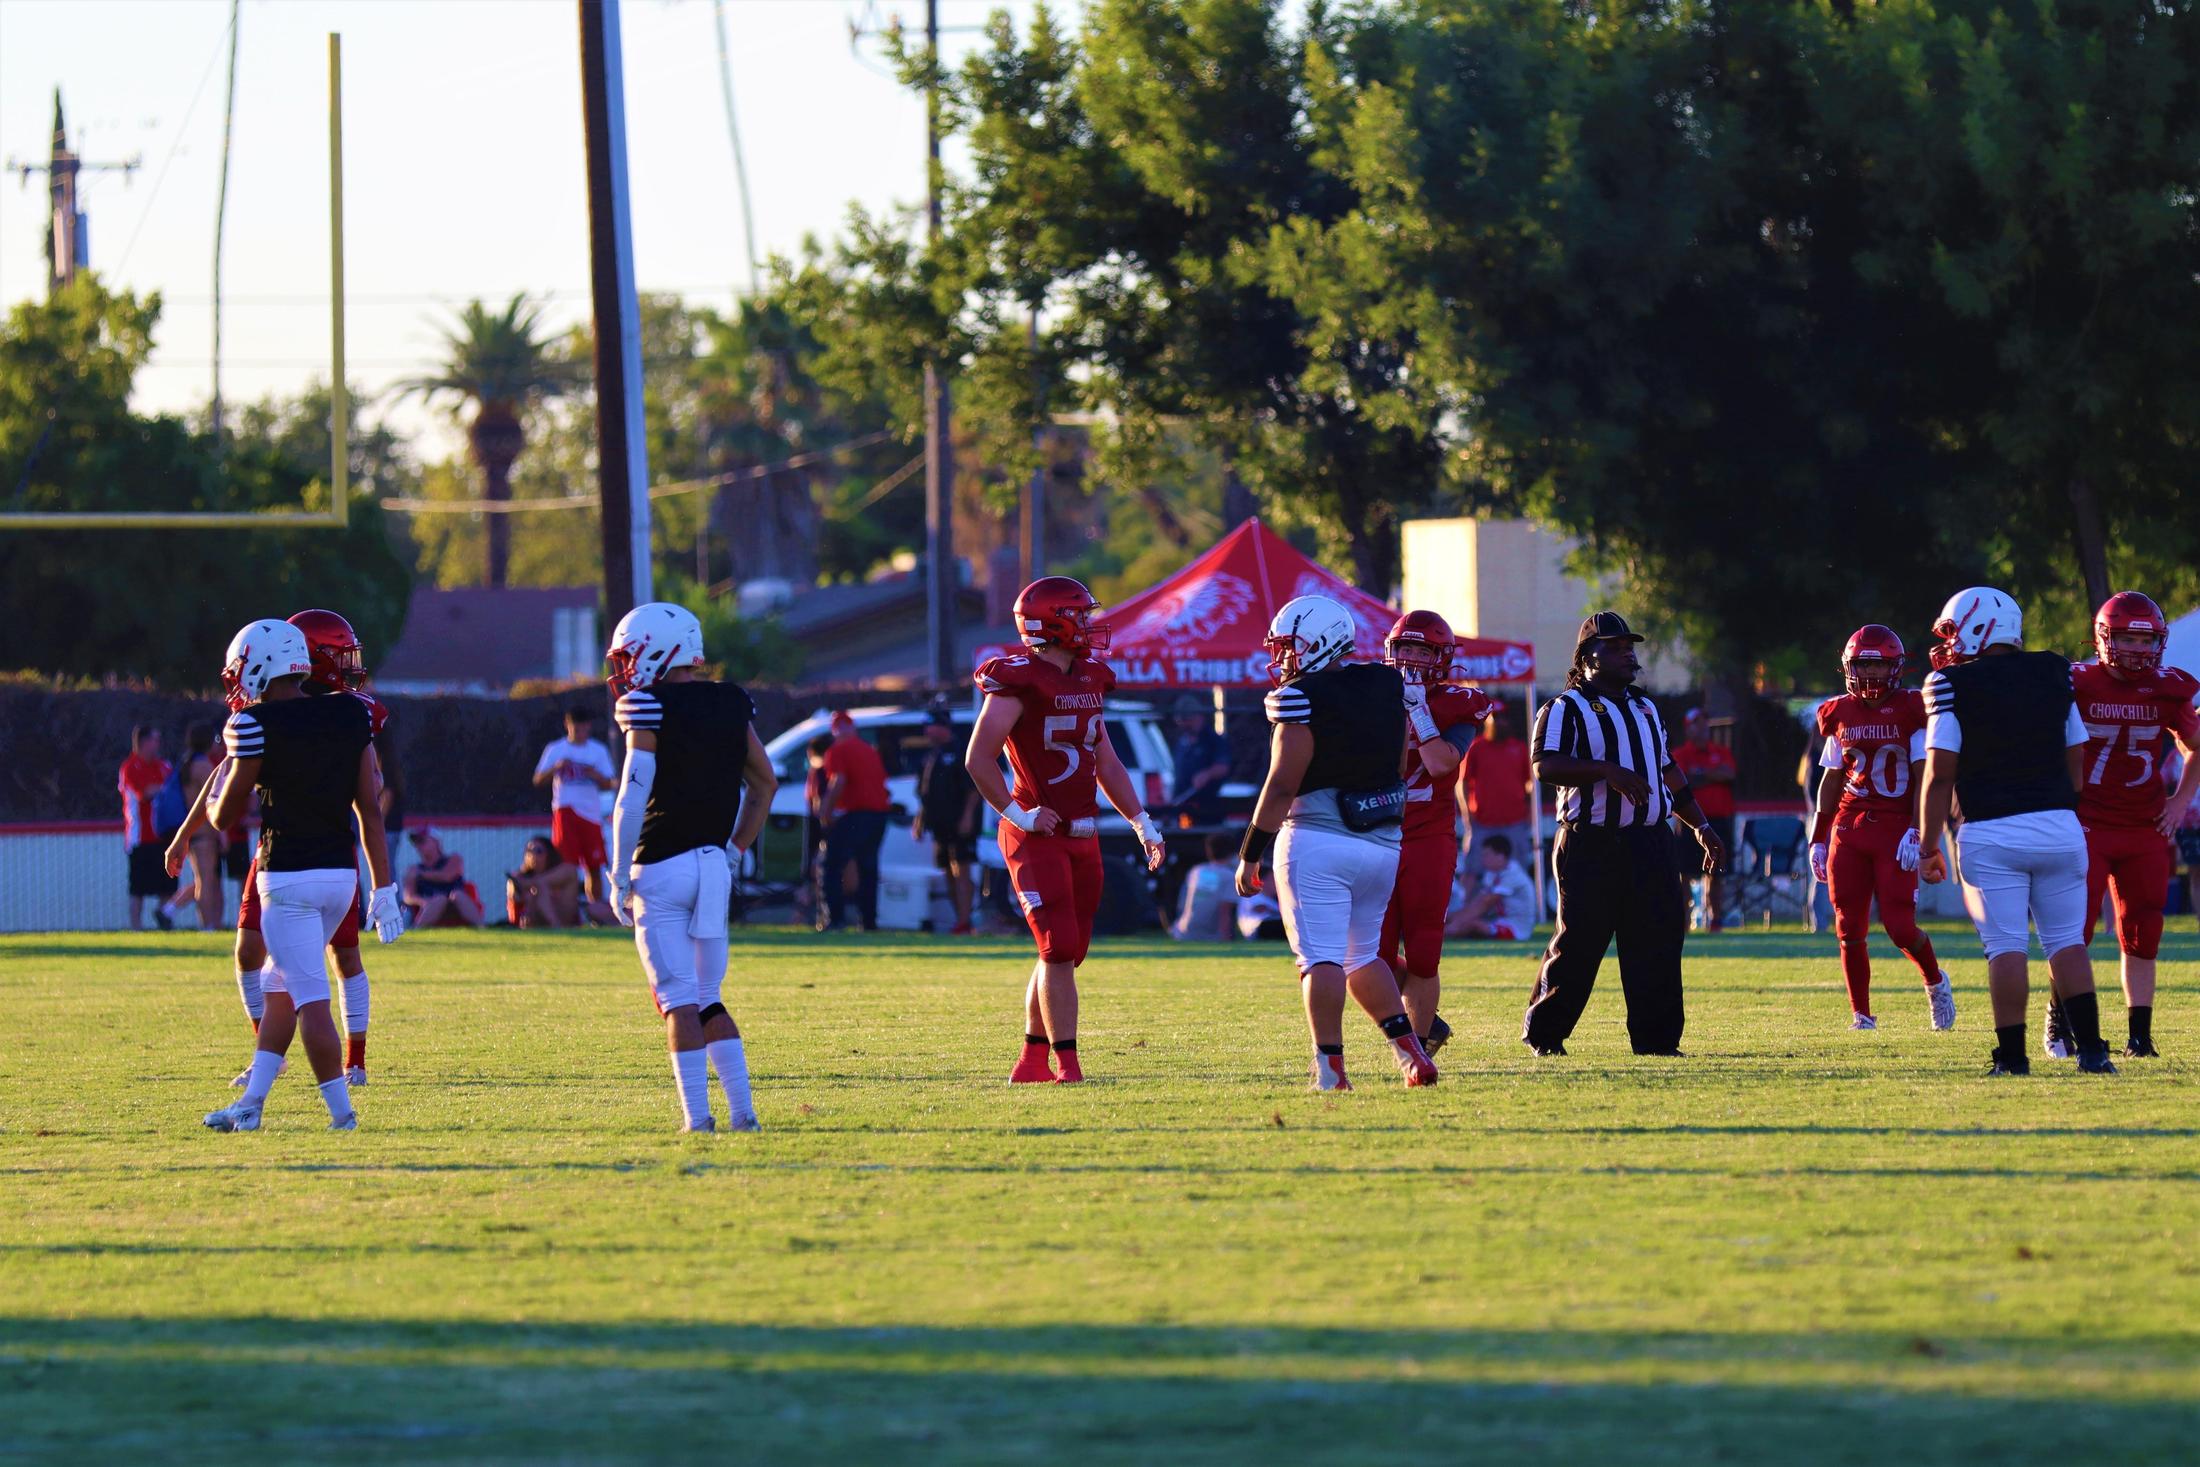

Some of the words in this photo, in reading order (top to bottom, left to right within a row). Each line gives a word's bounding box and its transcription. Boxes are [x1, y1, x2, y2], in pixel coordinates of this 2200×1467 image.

[1173, 658, 1243, 683] TRIBE
[2089, 703, 2159, 721] CHOWCHILLA
[1840, 724, 1900, 741] CHOWCHILLA
[2082, 721, 2161, 787] 75
[1357, 791, 1405, 812] XENITH
